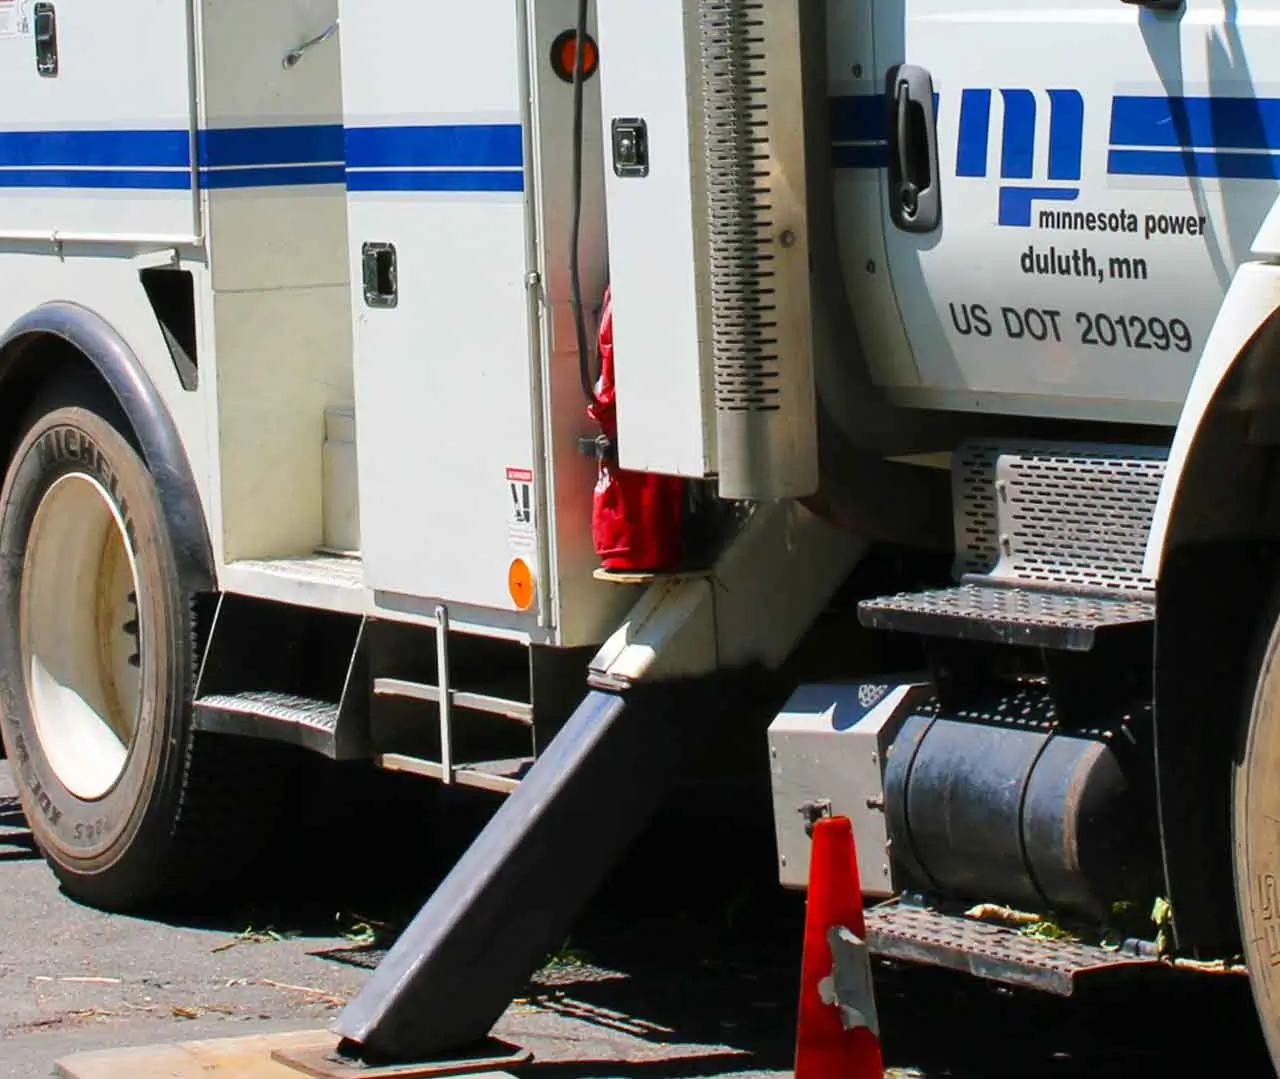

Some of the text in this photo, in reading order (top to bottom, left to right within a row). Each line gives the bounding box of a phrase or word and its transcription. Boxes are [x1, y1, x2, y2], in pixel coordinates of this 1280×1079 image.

[1038, 209, 1207, 240] minnesota power
[1020, 245, 1148, 284] duluth, mn
[948, 302, 1193, 354] US DOT 201299
